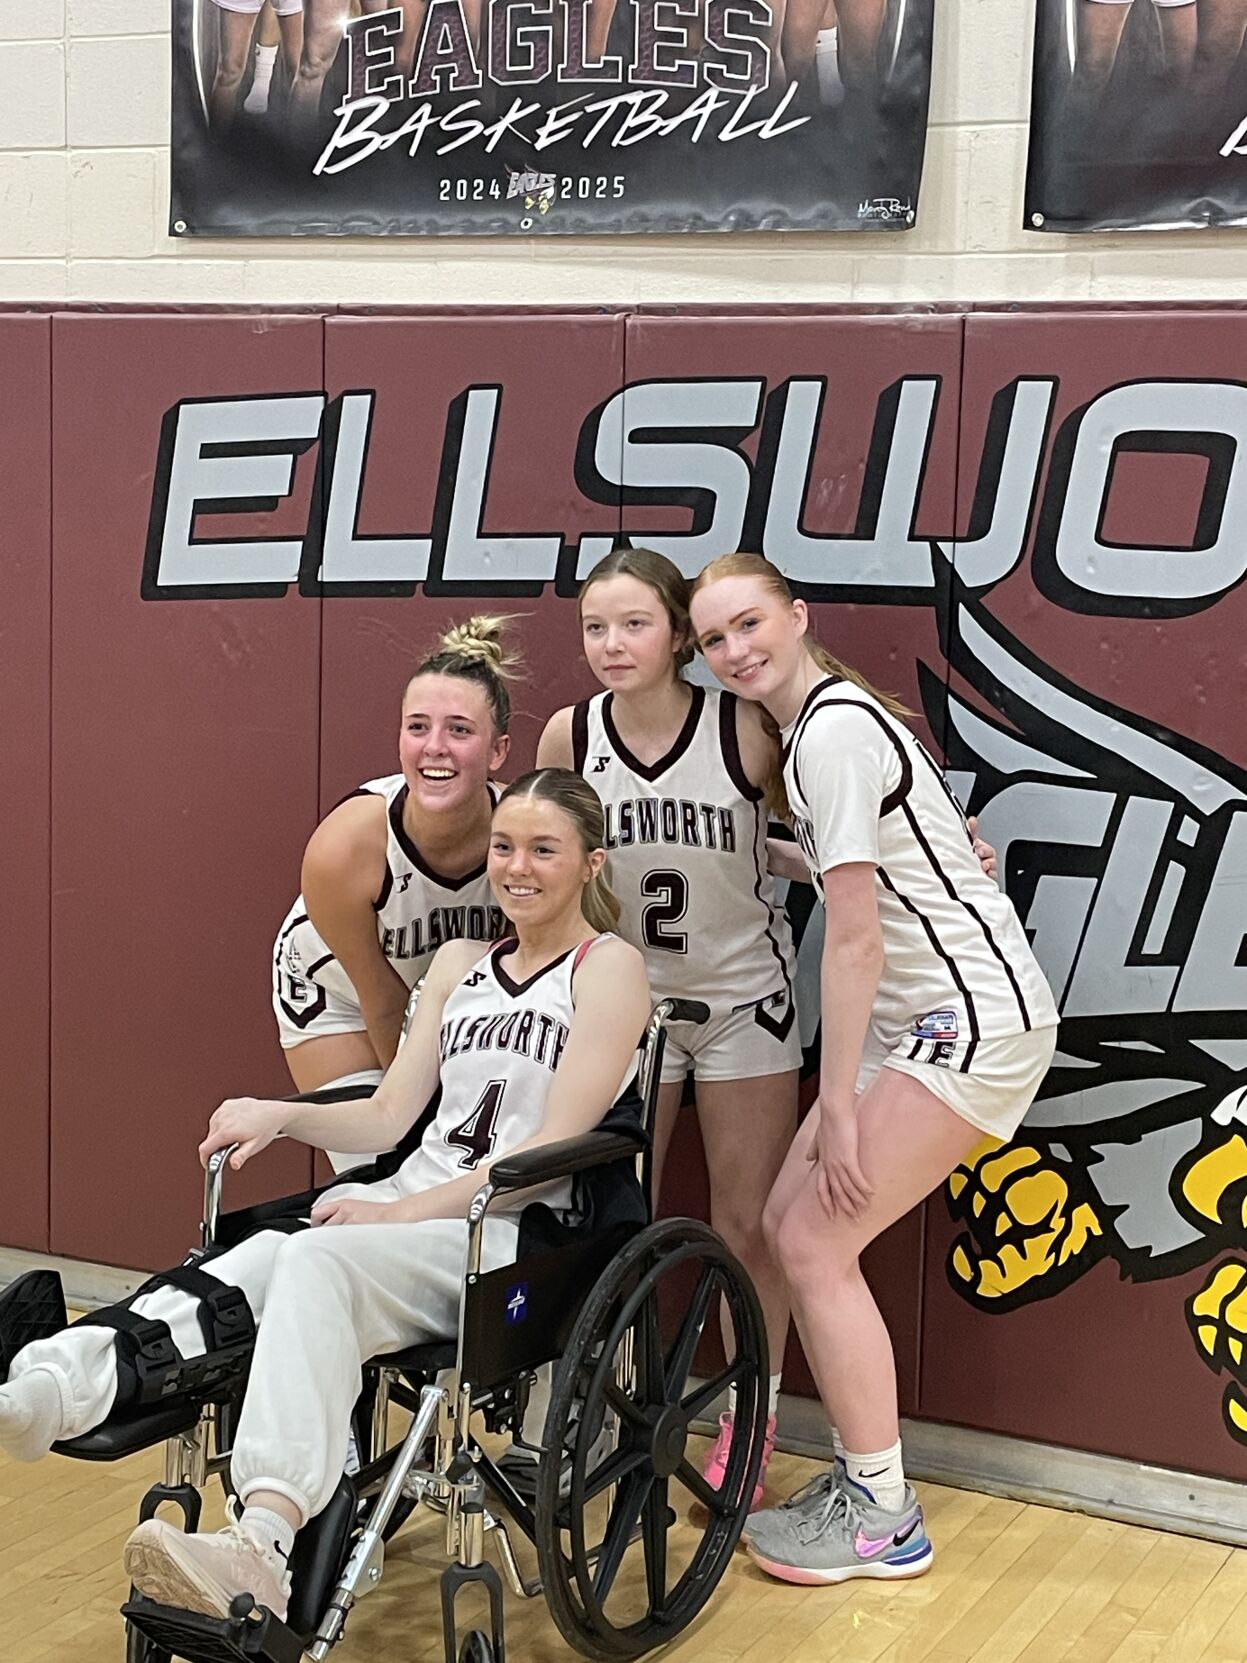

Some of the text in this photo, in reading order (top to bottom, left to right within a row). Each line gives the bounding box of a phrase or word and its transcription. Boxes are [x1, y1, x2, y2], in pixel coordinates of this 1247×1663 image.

[343, 0, 773, 106] EAGLES
[312, 81, 812, 175] BASKETBALL
[440, 178, 501, 201] 2024
[561, 176, 626, 199] 2025
[640, 868, 689, 955] 2
[444, 1079, 507, 1170] 4
